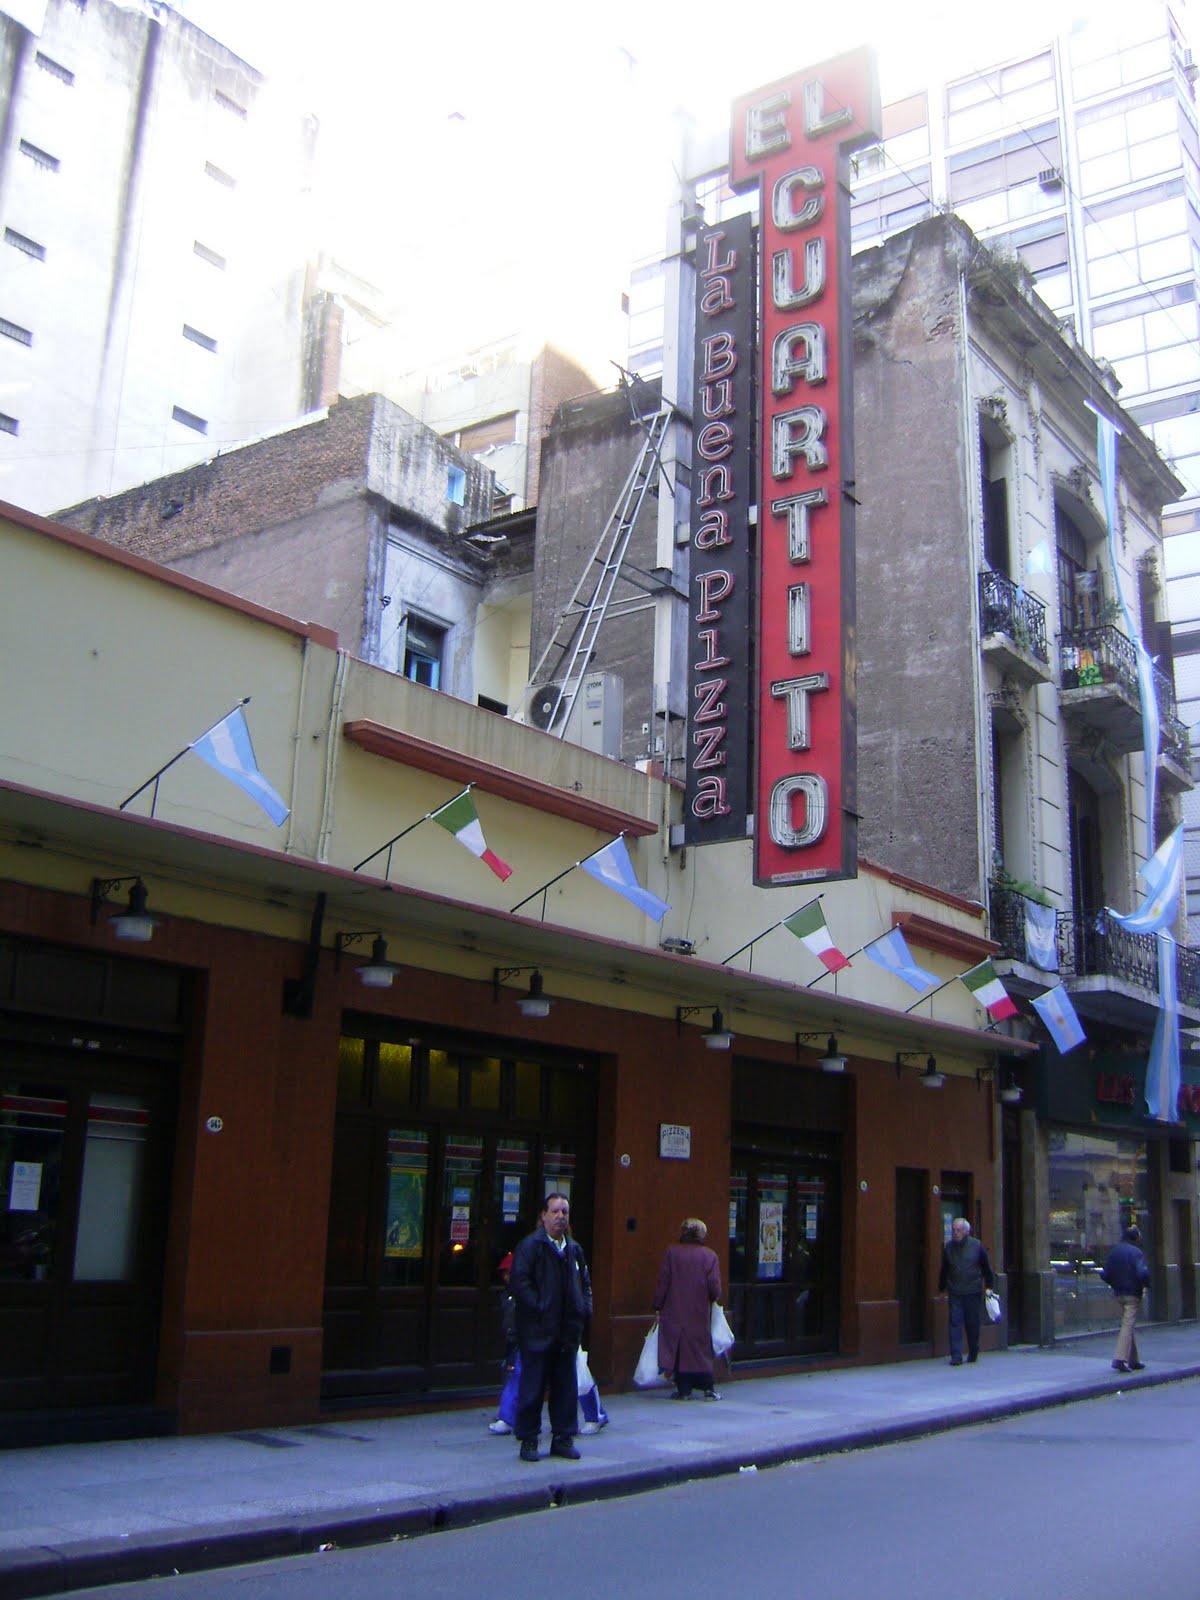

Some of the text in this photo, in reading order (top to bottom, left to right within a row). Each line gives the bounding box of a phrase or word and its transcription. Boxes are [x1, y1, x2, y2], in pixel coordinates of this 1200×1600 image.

[745, 76, 854, 165] EL
[691, 231, 738, 819] La Buena Pizza
[767, 166, 831, 852] CUARTITO
